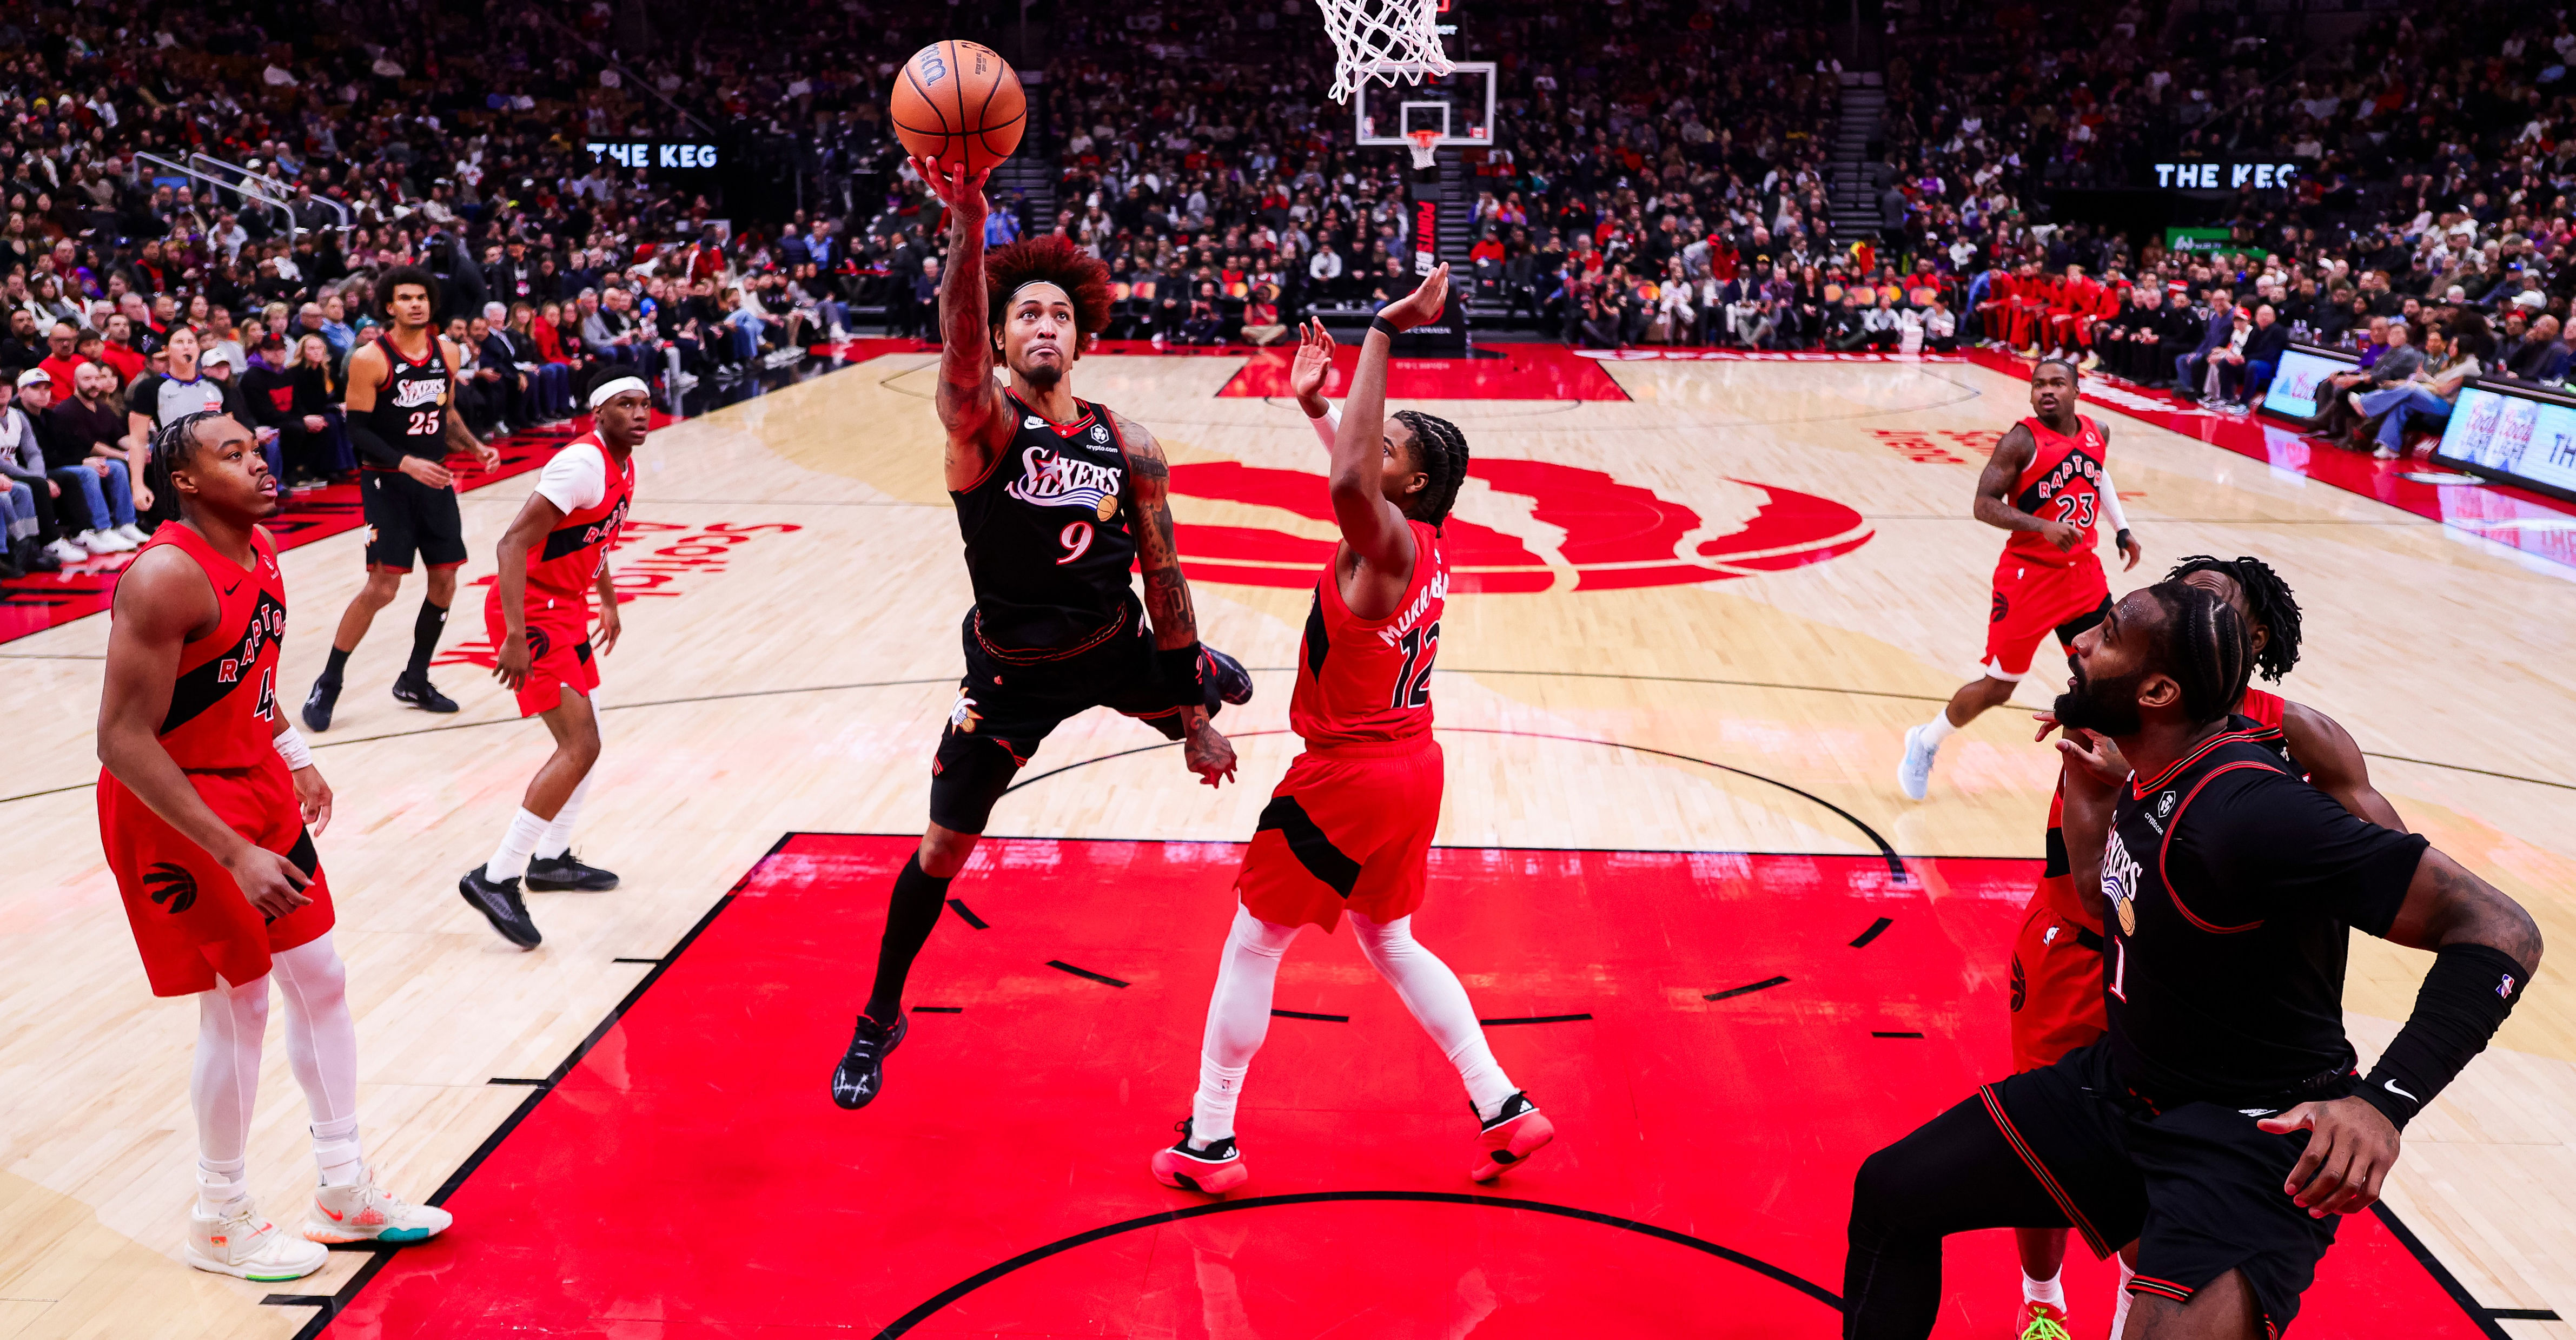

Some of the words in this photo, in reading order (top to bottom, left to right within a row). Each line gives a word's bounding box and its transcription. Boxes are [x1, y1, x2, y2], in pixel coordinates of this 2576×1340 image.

[586, 143, 649, 167] THE
[660, 144, 717, 167] KEG
[2155, 164, 2220, 188] THE
[407, 408, 440, 435] 25
[1028, 415, 1044, 425] NIKE
[1086, 444, 1118, 453] crypto.com
[1004, 446, 1122, 499] SIXERS
[2055, 493, 2095, 528] 23
[1056, 521, 1094, 565] 9
[218, 603, 287, 683] RAPTO
[1390, 620, 1440, 709] 12
[253, 665, 275, 722] 4
[2109, 935, 2127, 1004] 1
